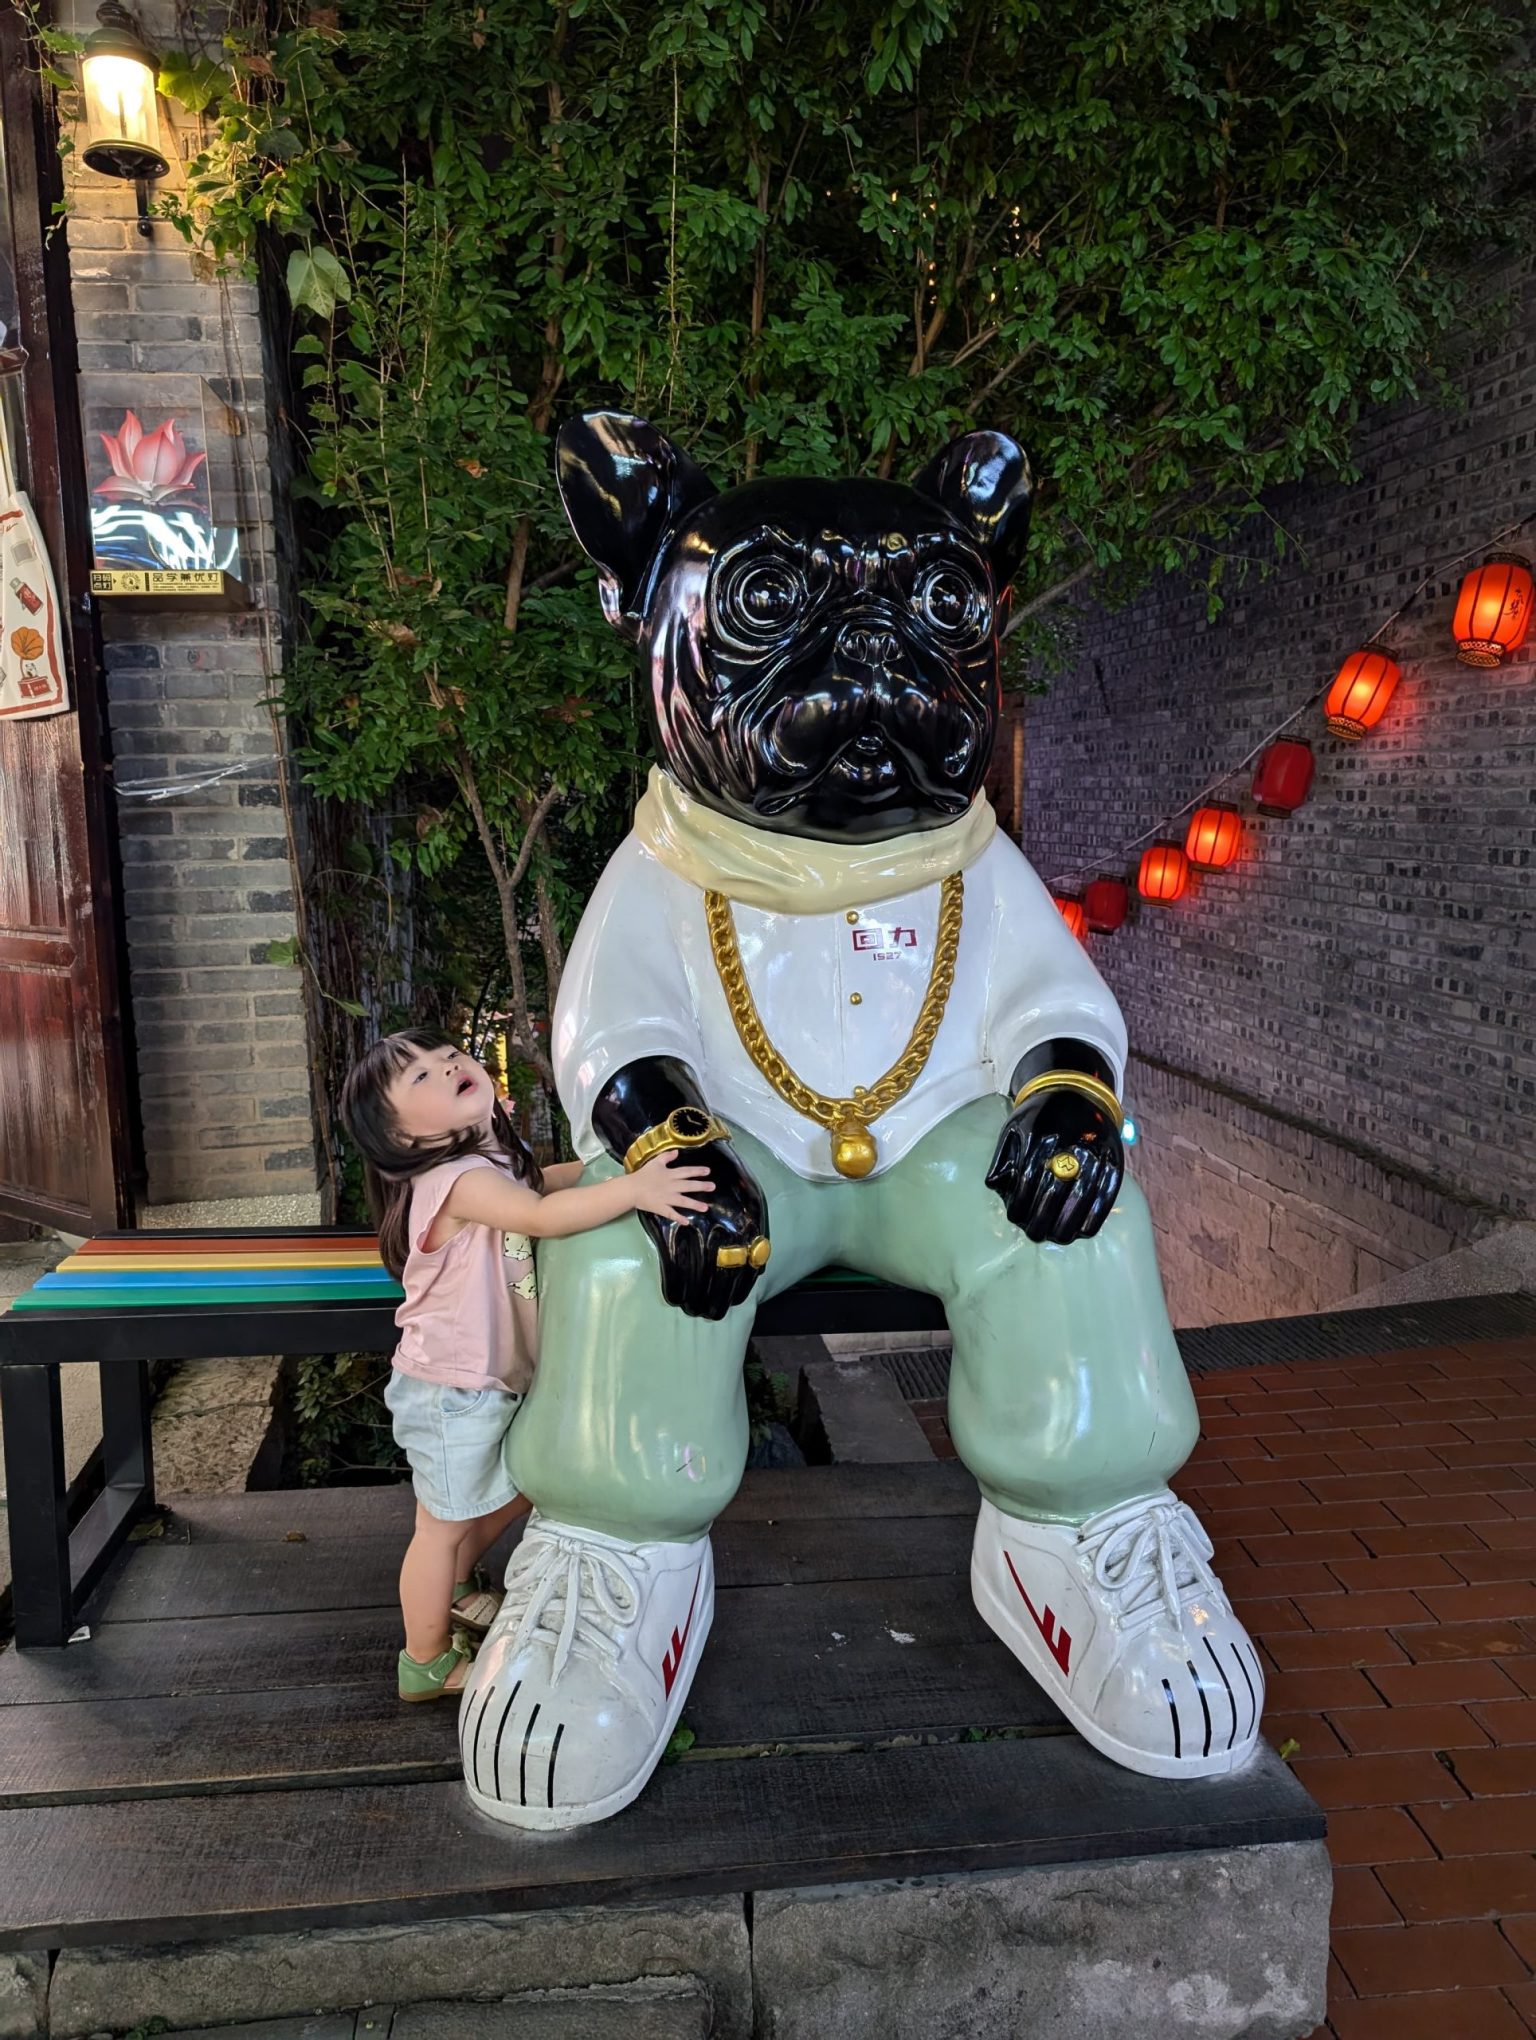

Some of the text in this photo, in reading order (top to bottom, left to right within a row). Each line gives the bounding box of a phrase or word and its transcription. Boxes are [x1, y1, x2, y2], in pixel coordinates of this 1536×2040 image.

[152, 572, 218, 582] 品学兼优灯
[852, 927, 917, 950] 回力
